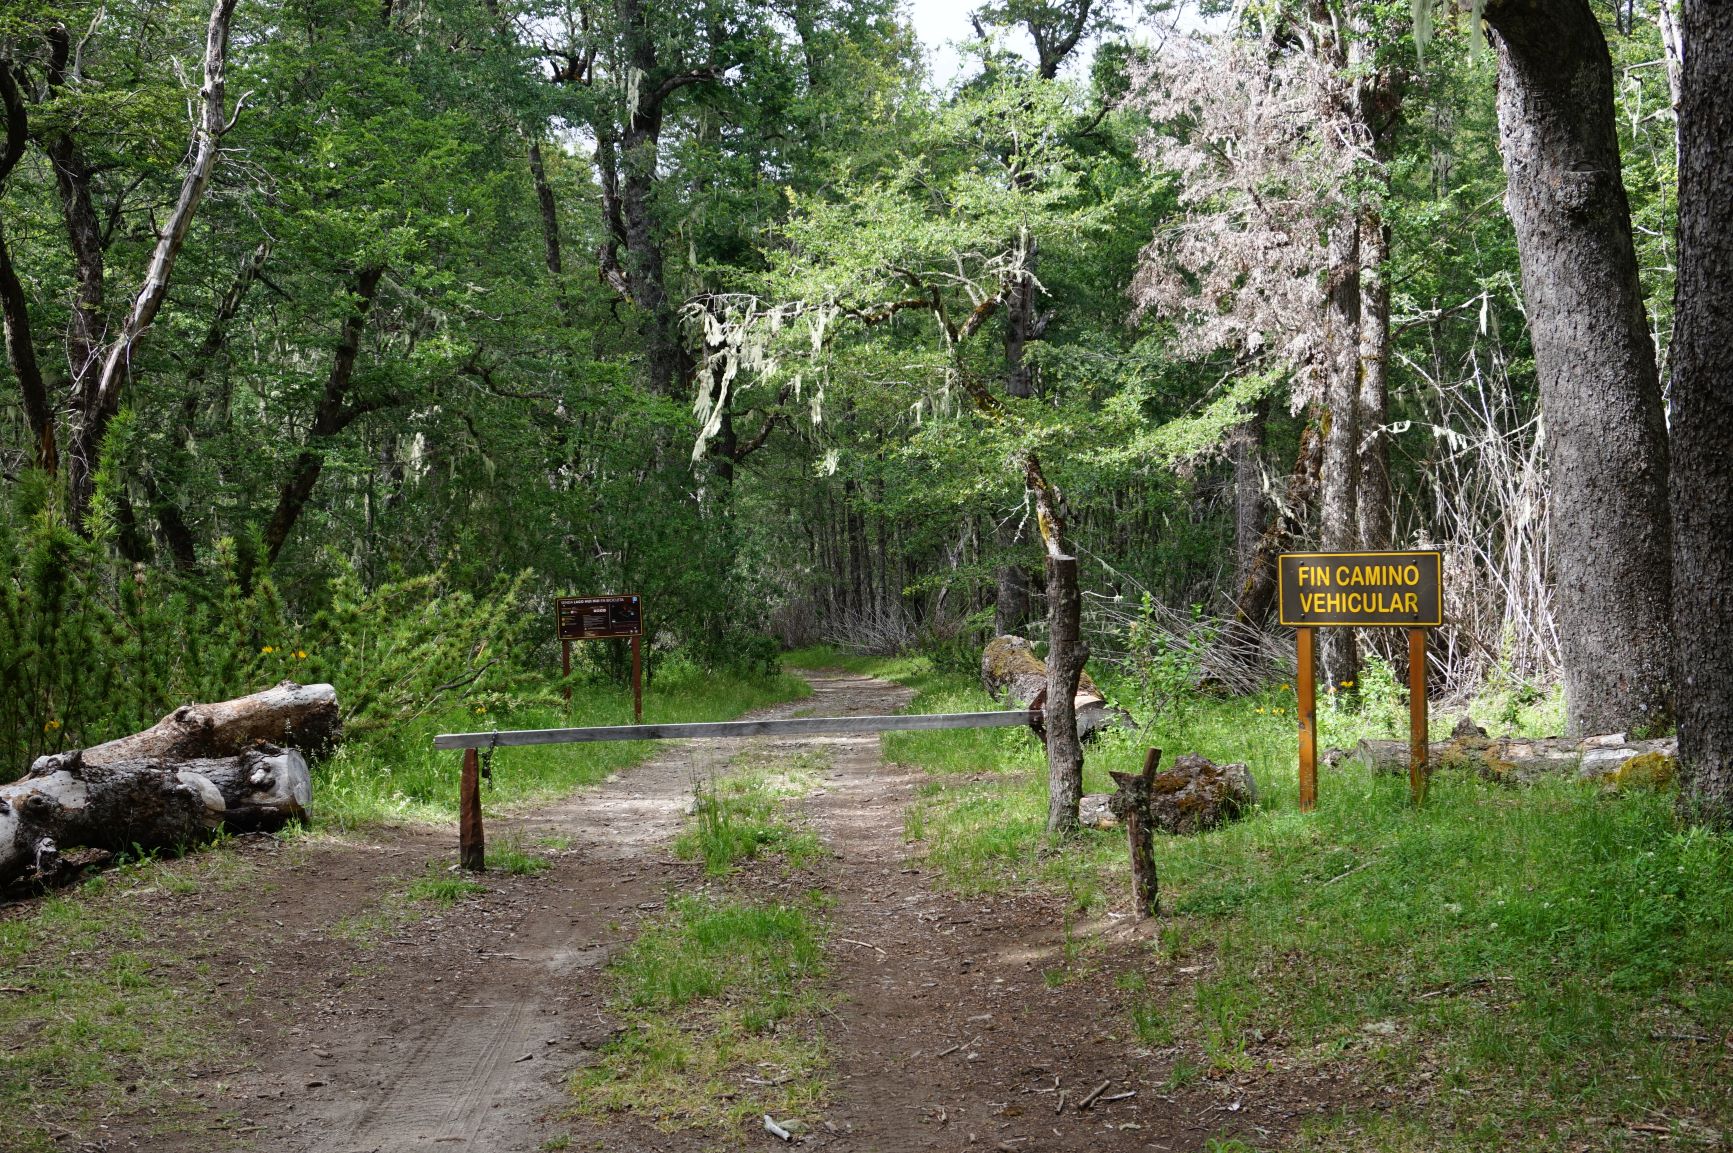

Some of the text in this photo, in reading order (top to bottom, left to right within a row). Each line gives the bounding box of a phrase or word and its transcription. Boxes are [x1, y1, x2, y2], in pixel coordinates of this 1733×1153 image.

[1298, 565, 1420, 587] FIN CAMINO
[1299, 592, 1419, 613] VEHICULAR
